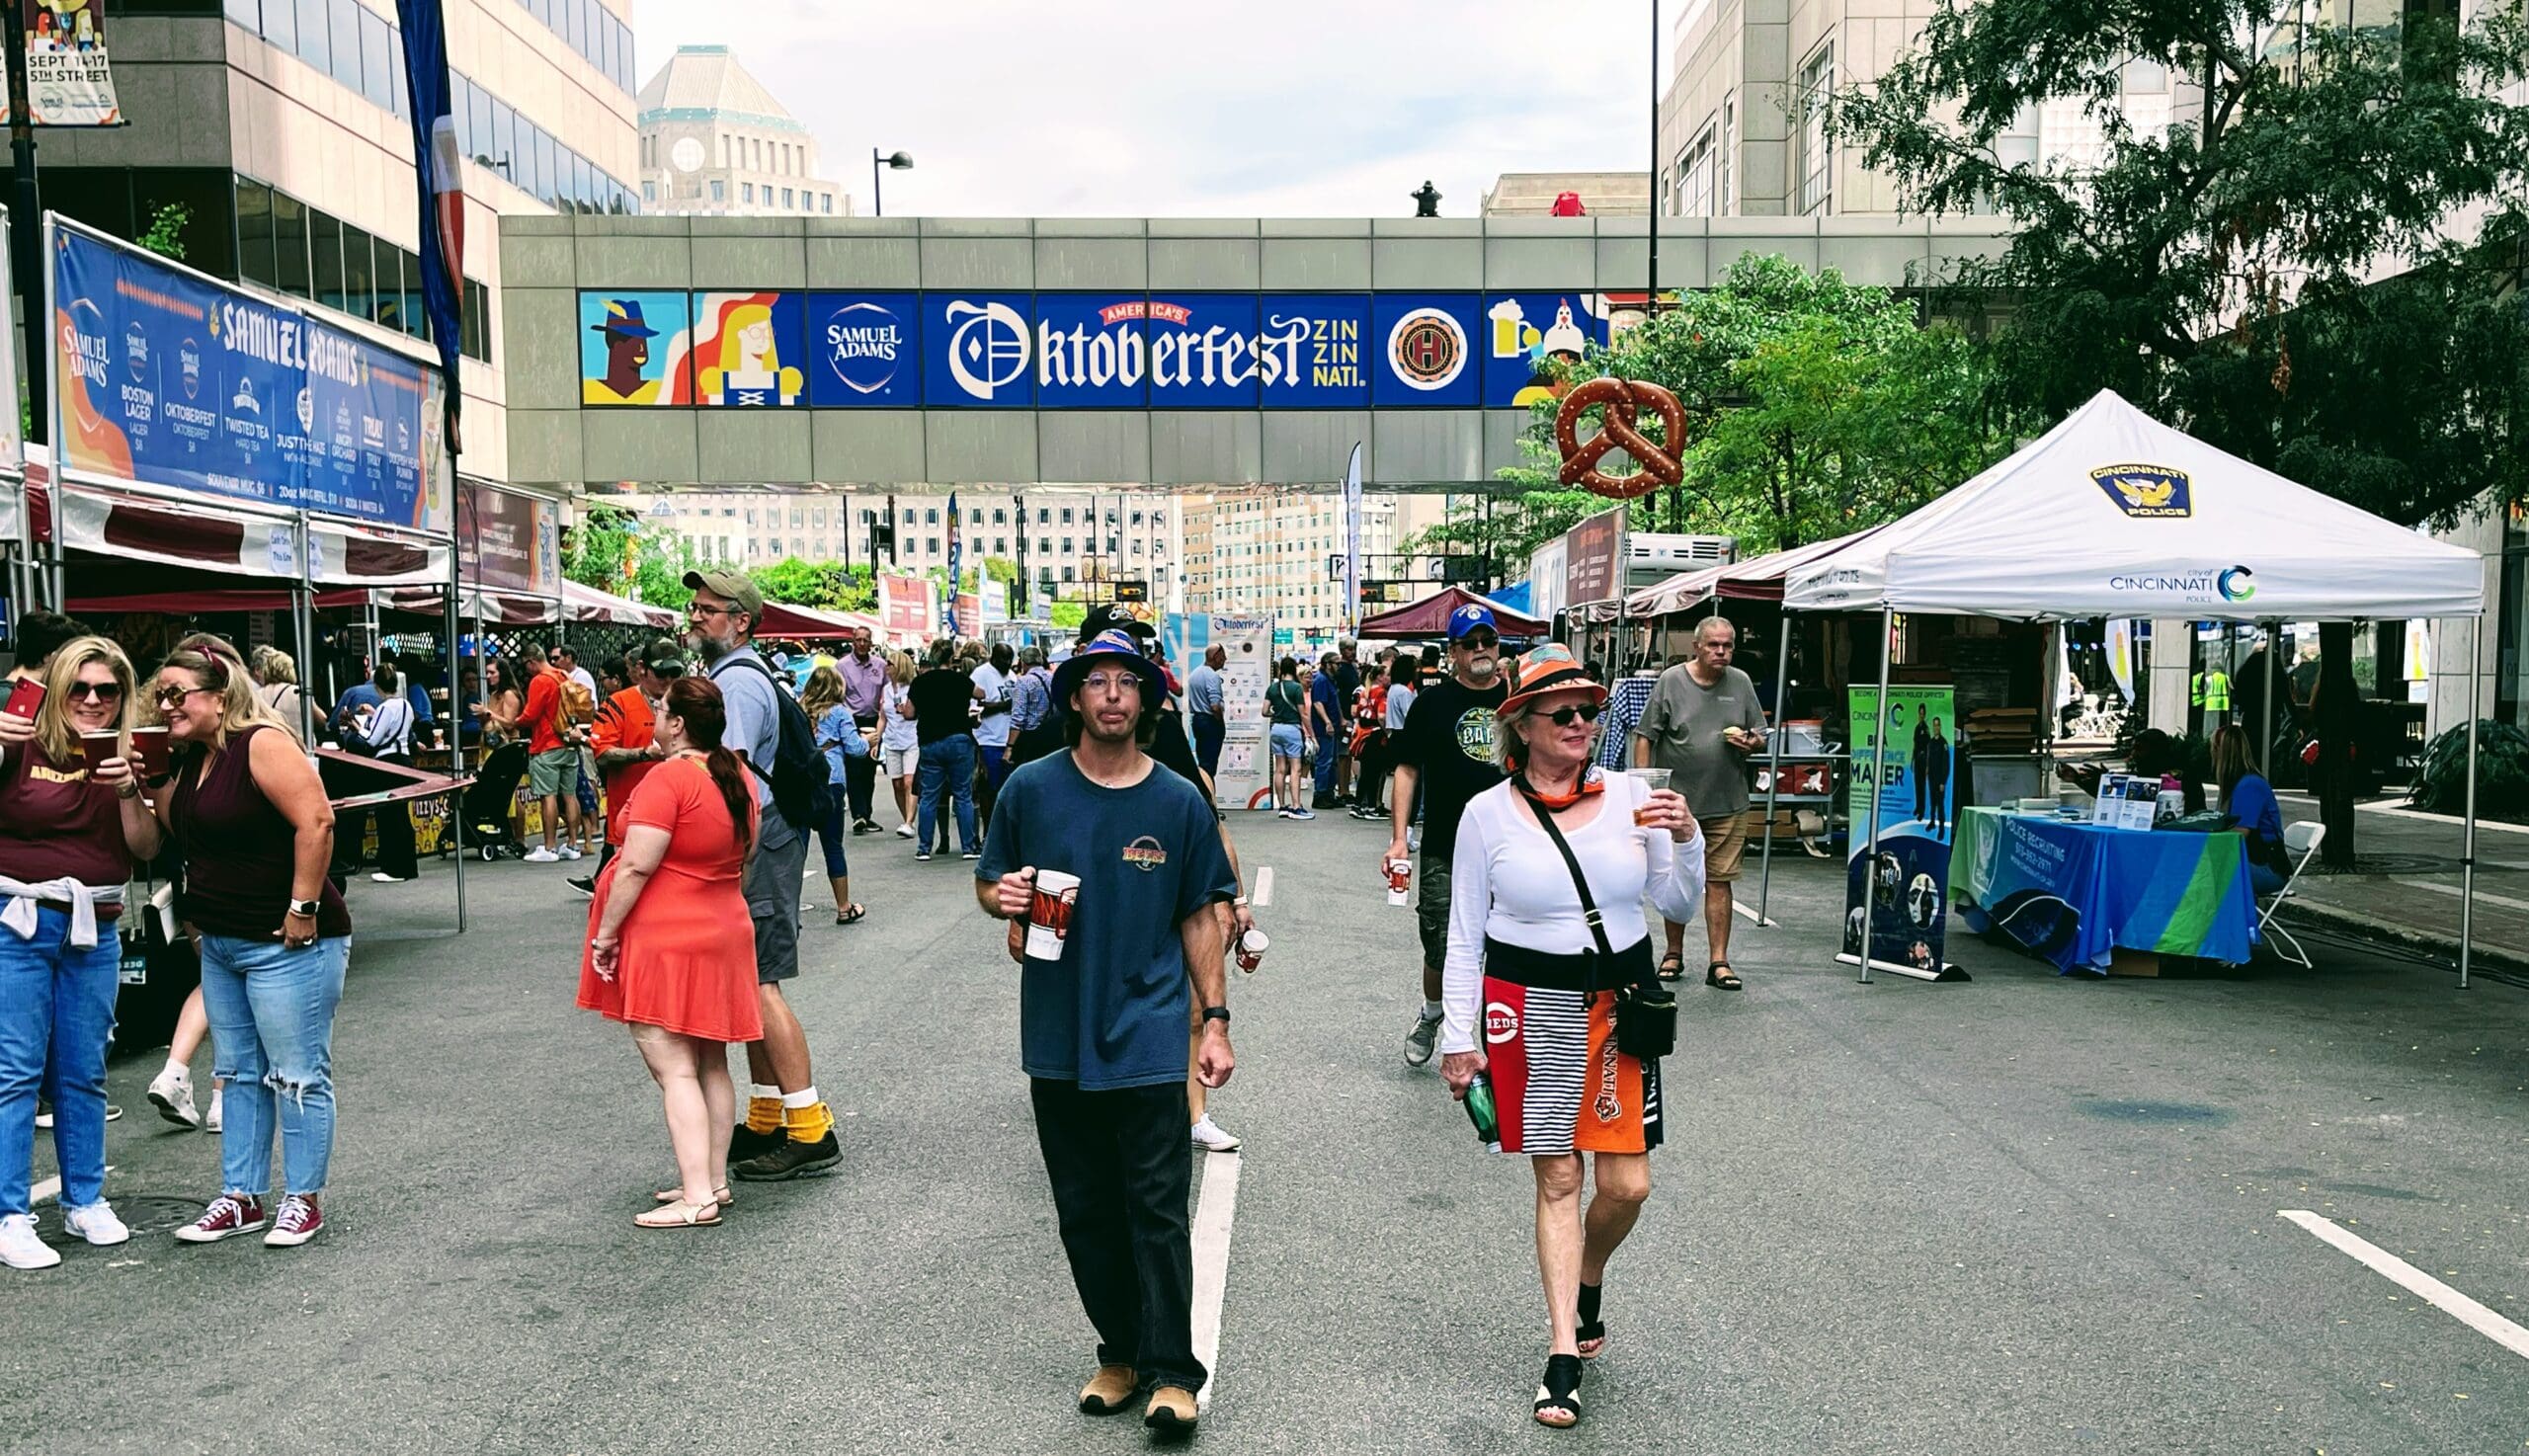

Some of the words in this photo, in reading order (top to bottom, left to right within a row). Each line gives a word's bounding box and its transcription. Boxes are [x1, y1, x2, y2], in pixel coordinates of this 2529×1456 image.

[29, 55, 67, 67] SEPT
[31, 70, 52, 82] 5TH
[57, 70, 109, 82] STREET
[1106, 303, 1184, 321] AMERICA'S
[223, 301, 306, 371] SAMUEL
[827, 323, 903, 346] SAMUEL
[1313, 319, 1358, 340] ZIN
[63, 325, 110, 364] SAMUEL
[834, 342, 896, 362] ADAMS
[947, 299, 1312, 400] Oktoberfest
[1313, 343, 1358, 364] ZIN
[308, 327, 358, 387] ADAMS
[69, 354, 107, 388] ADAMS
[121, 384, 154, 407] BOSTON
[124, 401, 151, 422] LAGER
[165, 402, 216, 428] OKTOBERFEST
[173, 423, 209, 441] OKTOBERFEST
[224, 416, 255, 437] TWISTED
[255, 422, 270, 440] TEA
[363, 415, 383, 440] TRULY
[277, 433, 297, 449] JUST
[206, 472, 239, 493] SOUVENIR
[2092, 465, 2186, 480] CINCINNATI
[279, 485, 297, 499] 20oz
[2127, 508, 2187, 517] POLICE
[2110, 577, 2213, 592] CINCINNATI
[1850, 762, 1906, 787] MAER
[2006, 817, 2026, 842] POLICE
[2027, 831, 2066, 862] RECRUITING
